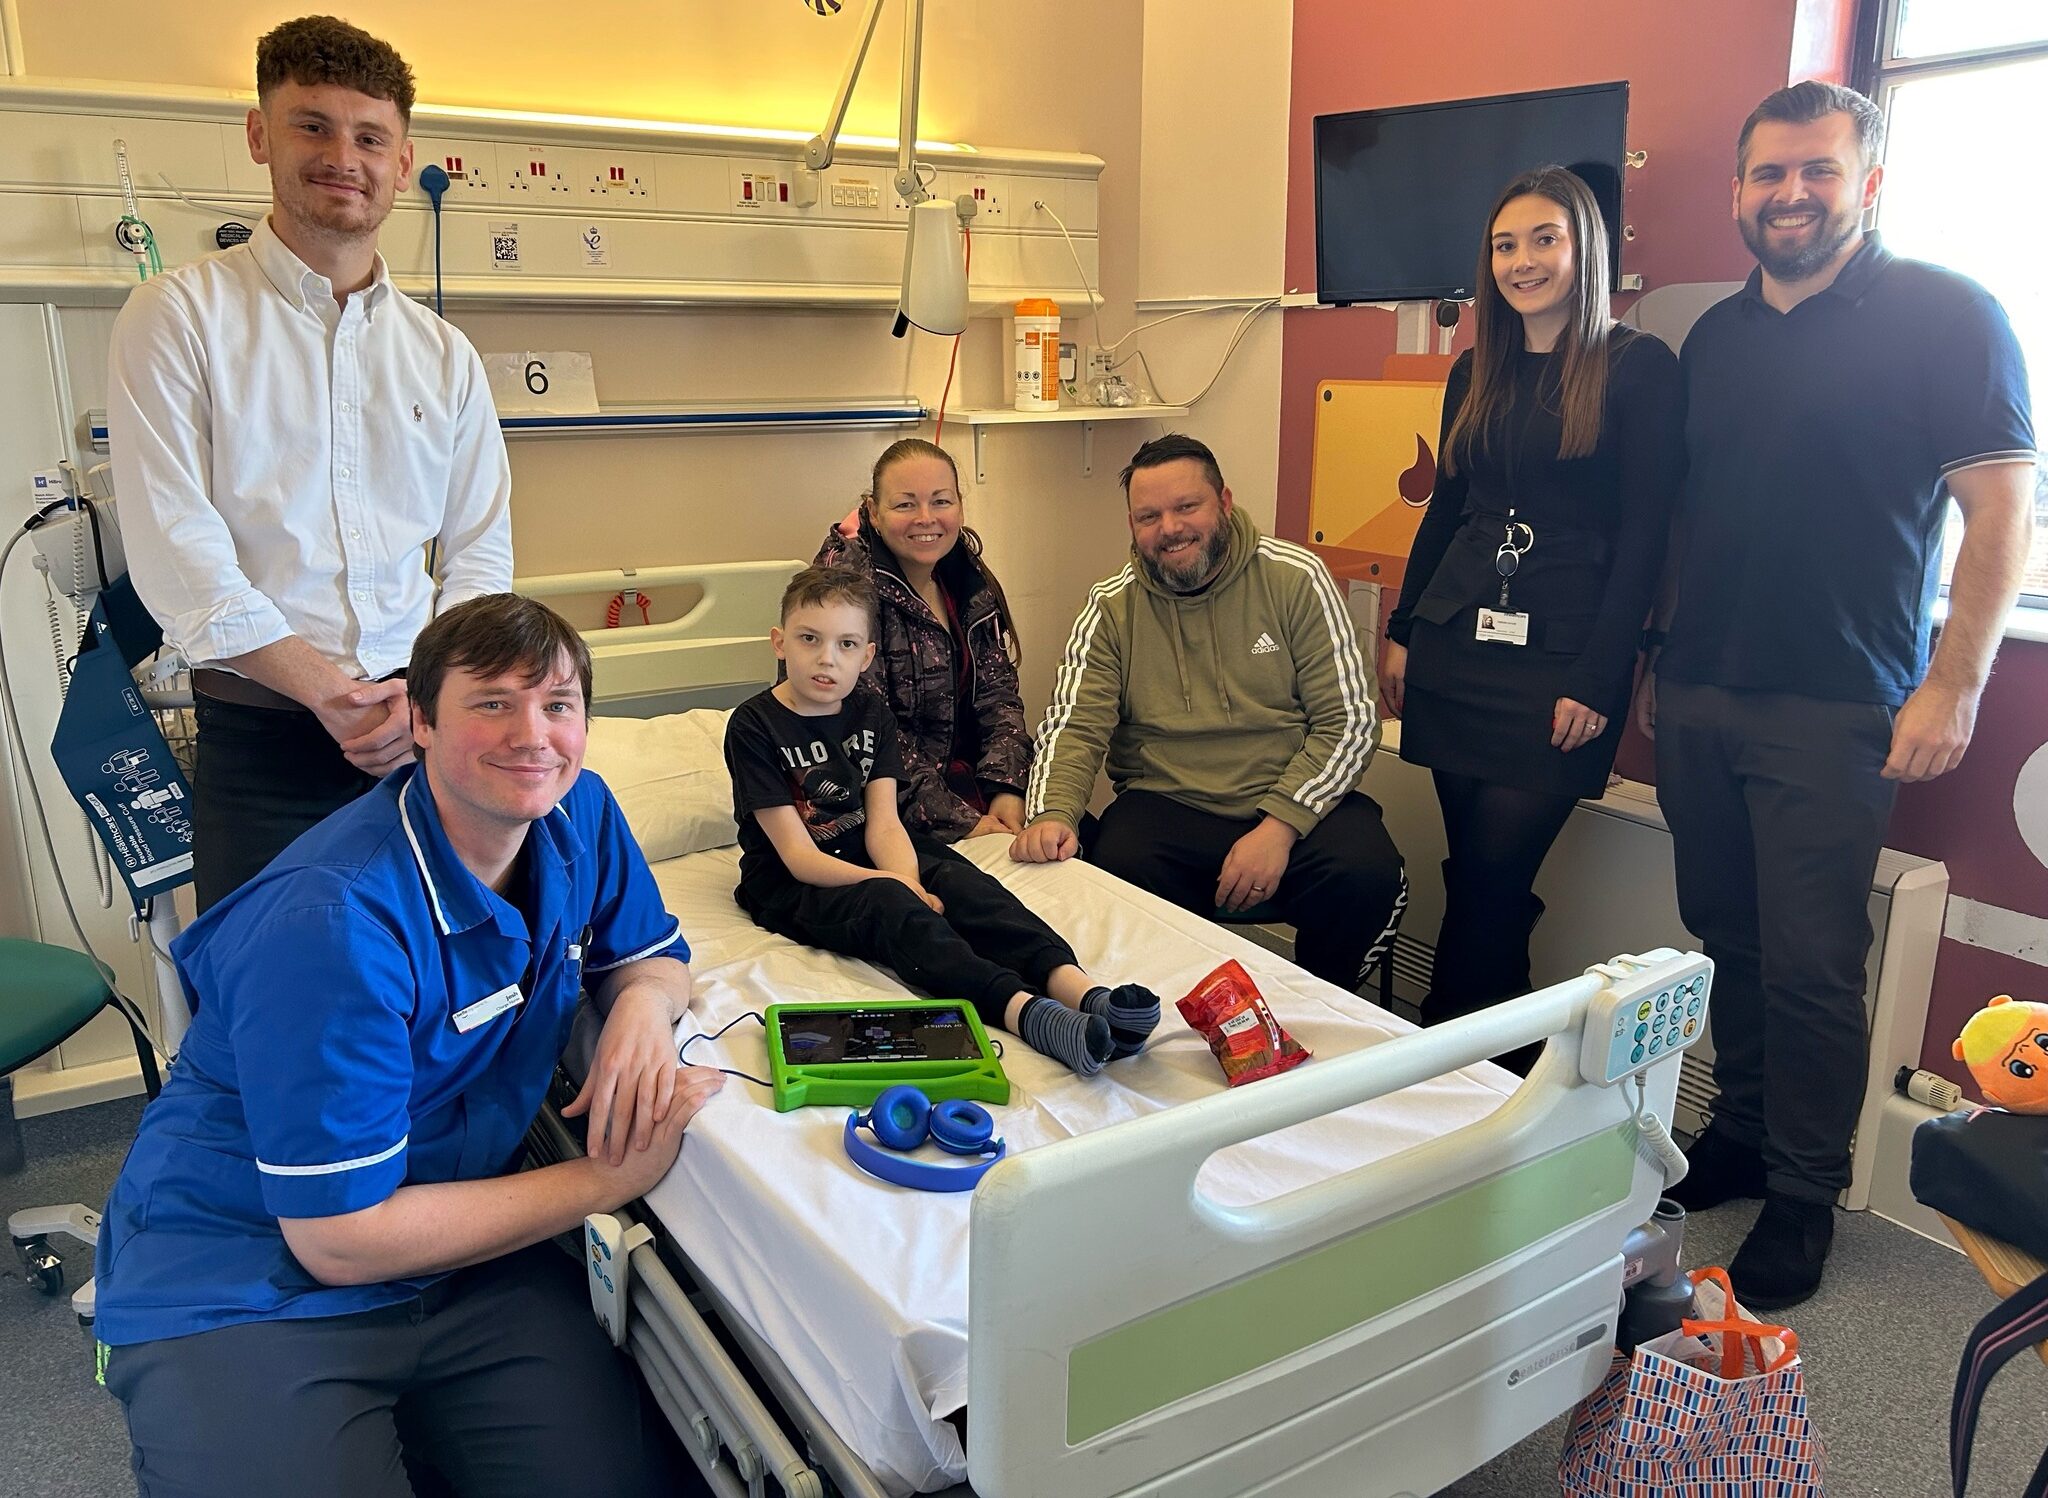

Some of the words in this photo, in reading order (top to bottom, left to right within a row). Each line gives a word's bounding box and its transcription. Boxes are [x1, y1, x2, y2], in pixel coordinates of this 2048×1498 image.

[525, 360, 548, 395] 6
[1251, 644, 1280, 655] adidas
[779, 740, 829, 769] YLO
[117, 802, 130, 816] Cuff
[105, 816, 131, 858] Healthcare
[127, 815, 145, 844] Pressure
[129, 835, 148, 865] Reusable
[141, 843, 155, 862] Blood
[495, 1003, 509, 1011] Charge
[1520, 1342, 1577, 1377] enterprise
